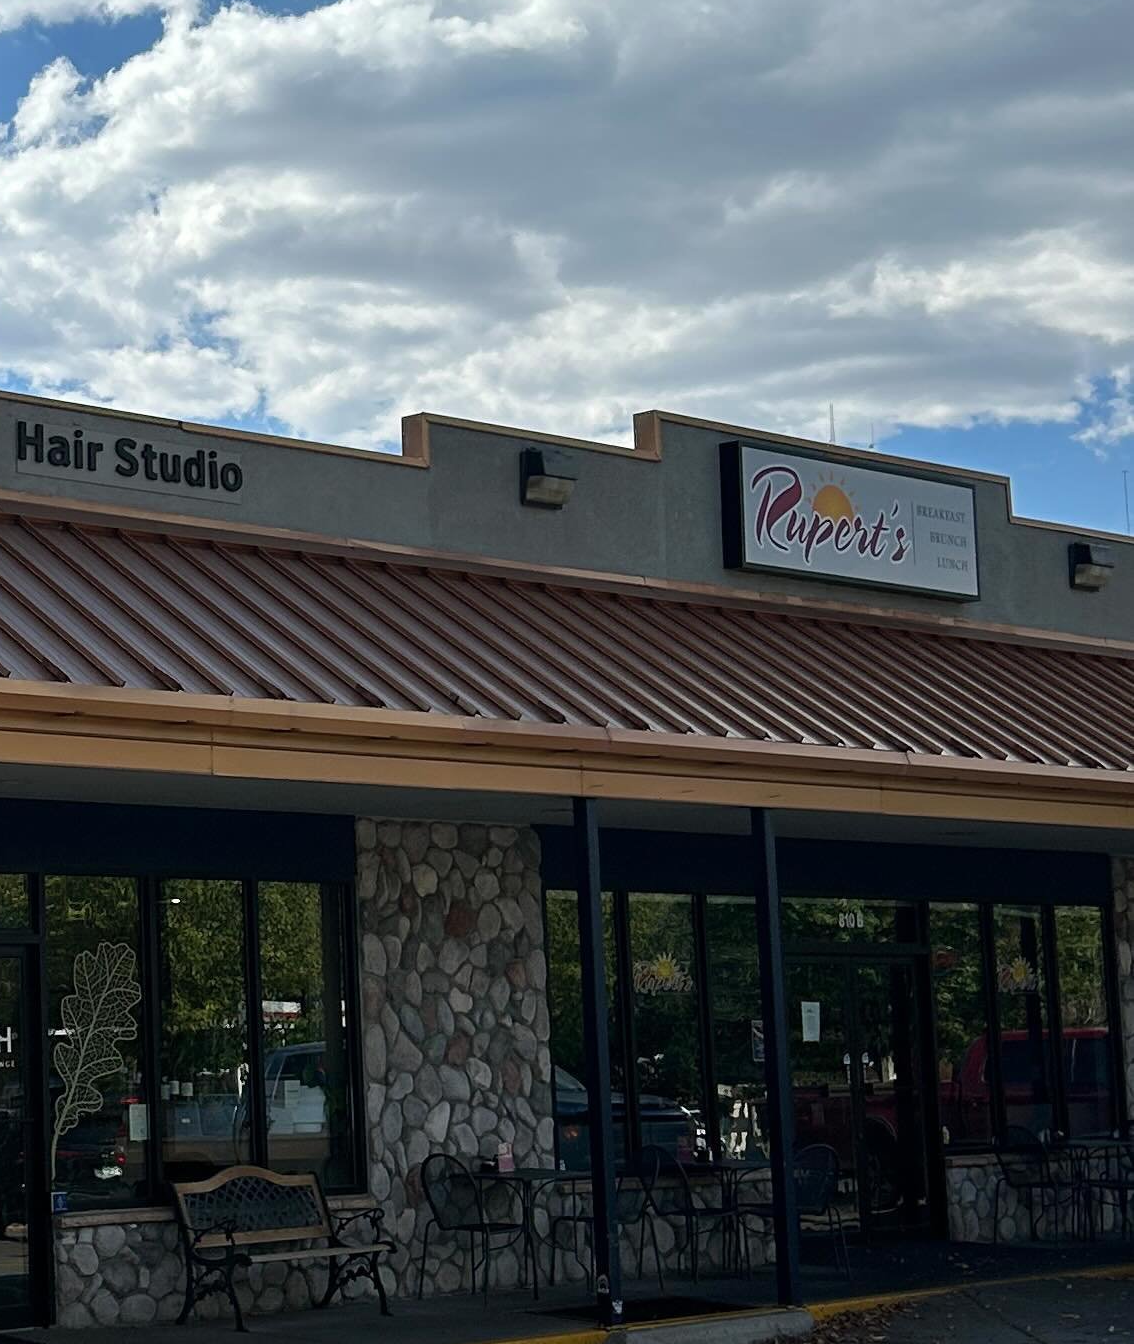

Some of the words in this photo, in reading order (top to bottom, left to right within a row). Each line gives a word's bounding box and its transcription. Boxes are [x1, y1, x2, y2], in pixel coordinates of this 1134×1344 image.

[18, 421, 103, 471] Hair
[115, 438, 243, 492] Studio
[751, 465, 910, 564] Rupert's
[916, 505, 966, 523] BREAKFAST
[929, 531, 967, 548] BRUNCH
[937, 556, 968, 571] LUNCH
[838, 912, 855, 928] 810
